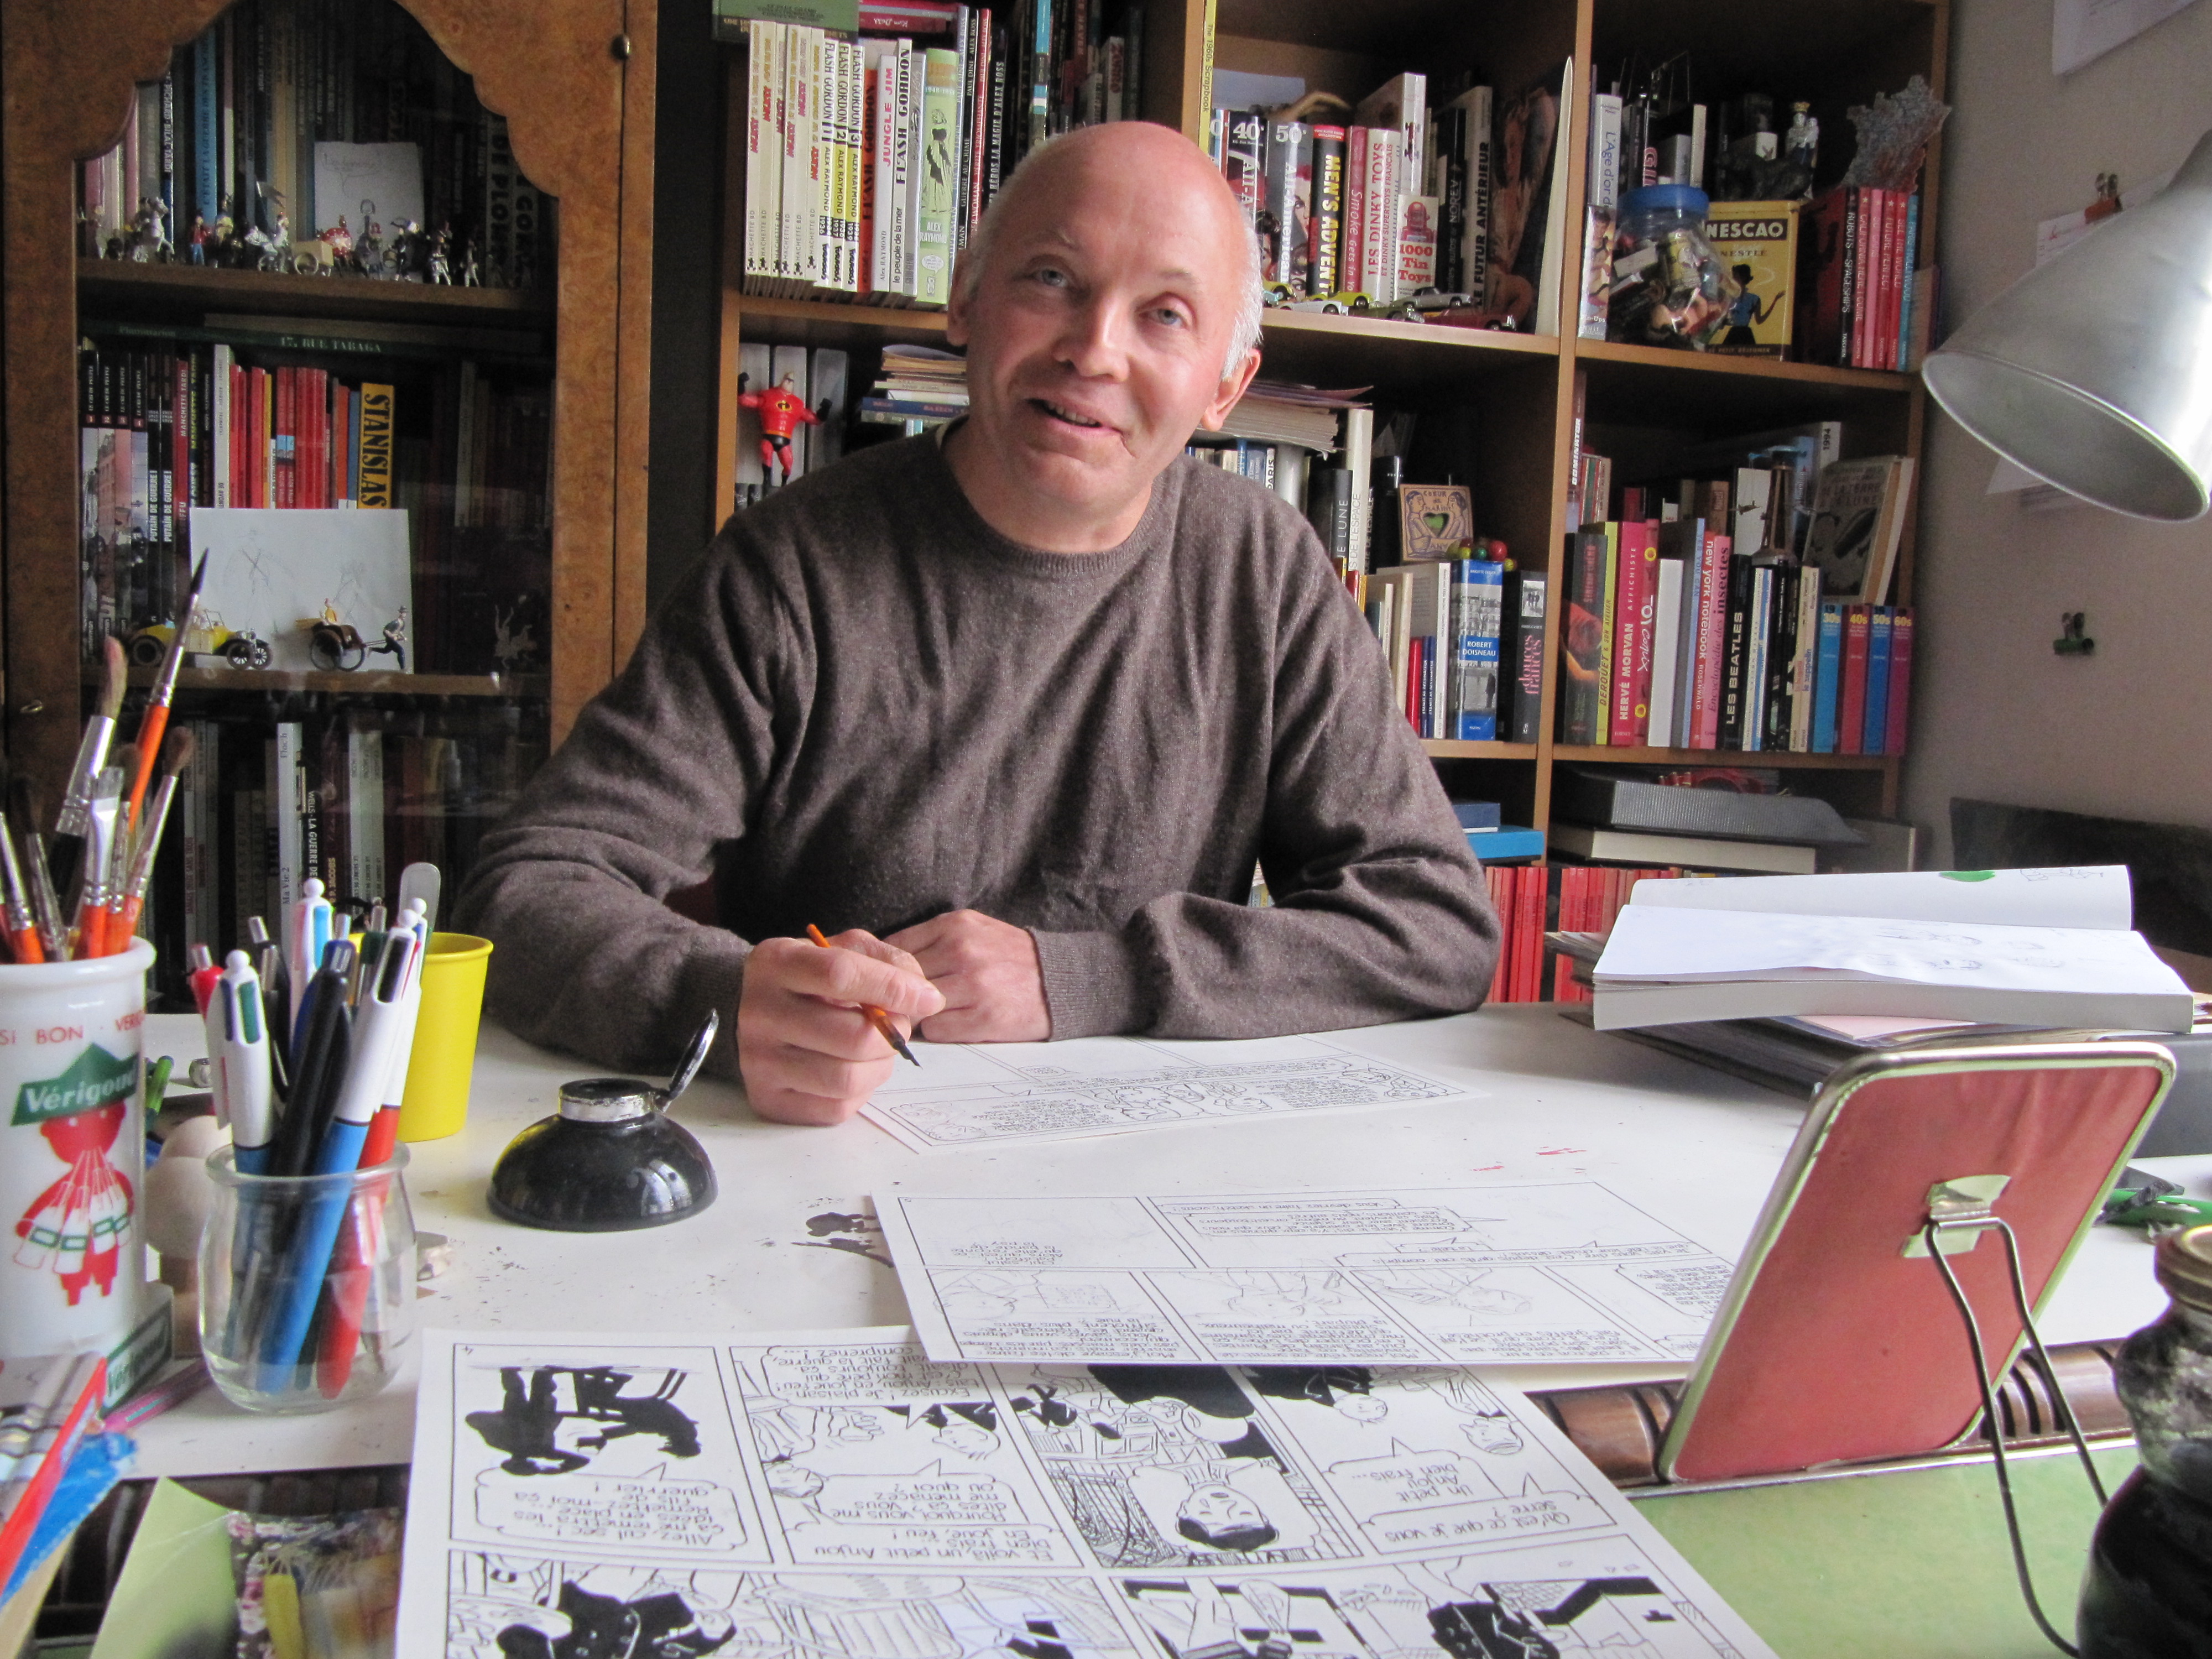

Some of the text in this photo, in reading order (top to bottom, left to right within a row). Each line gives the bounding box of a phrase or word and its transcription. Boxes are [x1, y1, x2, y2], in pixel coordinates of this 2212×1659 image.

[825, 42, 834, 72] FLASH
[839, 46, 848, 76] FLASH
[853, 50, 861, 80] FLASH
[898, 49, 910, 117] GORDON
[1203, 65, 1211, 112] Scrapbook
[823, 77, 833, 119] GORDON
[838, 81, 847, 122] GORDON
[883, 102, 891, 166] JUNGLE
[896, 128, 907, 184] FLASH
[992, 149, 1000, 159] LA
[989, 163, 999, 190] HÉROS
[1322, 155, 1340, 212] MEN'S
[1604, 169, 1614, 194] d'or
[960, 178, 968, 206] GUERRE
[1449, 179, 1461, 223] NOREV
[1281, 162, 1296, 283] All-American
[1368, 143, 1383, 275] LES DINKY TOYS
[1474, 142, 1488, 283] FUTUR ANTÉRIEUR
[894, 233, 901, 244] de
[920, 232, 947, 244] RAYMOND
[926, 222, 941, 231] ALEX
[1348, 189, 1363, 275] Smoke Gets in
[1706, 222, 1783, 238] NESCAO
[1846, 212, 1855, 248] ROBOTS
[893, 246, 901, 274] peuple
[1400, 244, 1433, 256] 1000
[1402, 257, 1428, 269] Tin
[1381, 267, 1387, 276] ET
[1398, 269, 1431, 284] Toys
[1842, 259, 1853, 313] SPACESHIPS
[361, 394, 390, 507] STANISLAS
[1572, 418, 1580, 486] DOMINATOR
[150, 504, 158, 513] DE
[164, 504, 172, 513] DE
[1338, 500, 1348, 537] LUNE
[1350, 494, 1360, 558] DE L'ESPACE
[1705, 541, 1714, 566] new
[1702, 570, 1712, 597] york
[1714, 547, 1729, 614] insectes
[1699, 601, 1710, 659] notebook
[1850, 614, 1867, 624] 40s
[1619, 547, 1636, 720] HERVÉ MORVAN AFFICHISTE
[1599, 655, 1609, 706] DEROUET
[1726, 612, 1743, 724] LES BEATLES
[308, 818, 316, 829] LA
[309, 832, 317, 864] GUERRE
[36, 1026, 84, 1044] BON
[822, 1347, 913, 1358] comprenez
[838, 1358, 853, 1366] la
[860, 1355, 891, 1365] fait
[902, 1387, 970, 1398] Excusez
[1407, 1475, 1458, 1488] Anjou
[1419, 1463, 1459, 1477] bien
[875, 1492, 961, 1502] menacez
[914, 1482, 993, 1494] ou quoi
[1396, 1485, 1474, 1503] Un petit
[831, 1509, 1006, 1522] Pourquoi vous me
[958, 1501, 1006, 1513] dites
[1512, 1501, 1557, 1514] serre
[904, 1528, 1029, 1540] En feu
[1385, 1512, 1570, 1542] Qu'est ce que je vous
[815, 1545, 1053, 1561] Et un petit Anjou
[1006, 1539, 1051, 1551] bien
